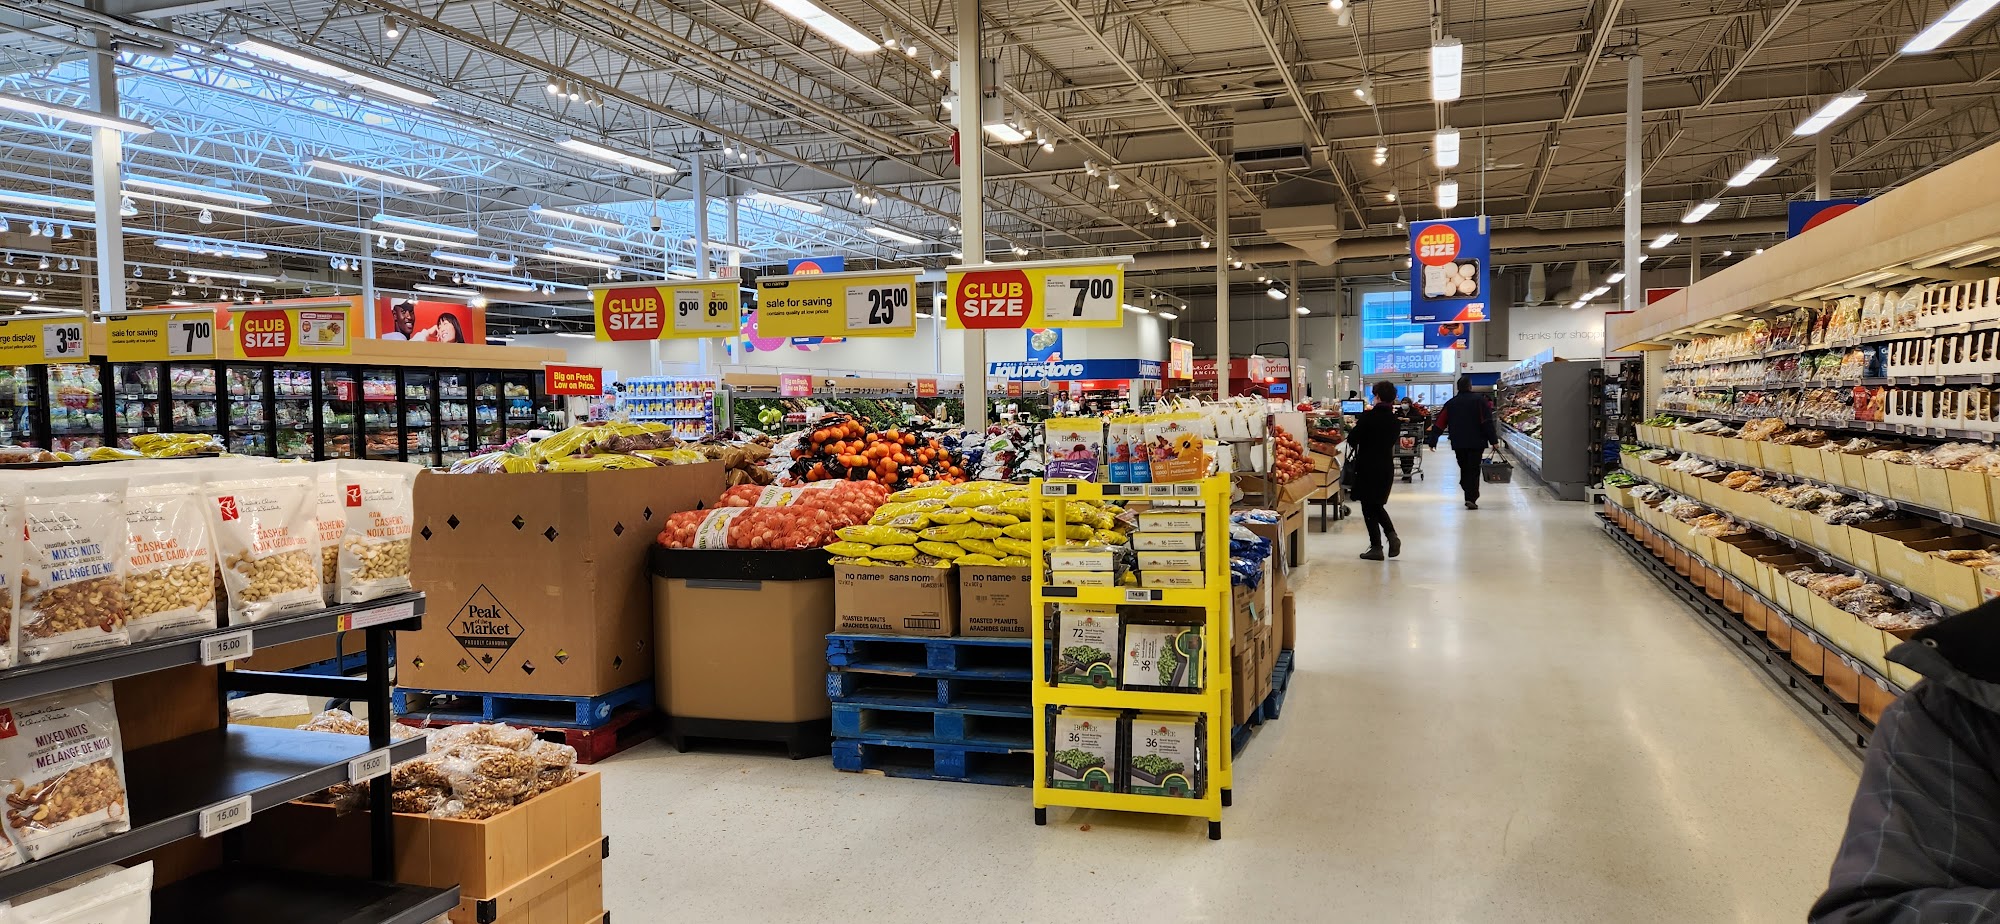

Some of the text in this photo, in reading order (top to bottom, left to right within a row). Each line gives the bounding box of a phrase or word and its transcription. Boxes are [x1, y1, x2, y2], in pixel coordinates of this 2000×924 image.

[1420, 233, 1455, 246] CLUB
[1420, 244, 1455, 257] SIZE
[719, 267, 733, 278] EXIT
[963, 282, 1023, 298] CLUB
[608, 298, 657, 313] CLUB
[766, 296, 832, 308] sale for saving
[963, 298, 1023, 317] SIZE
[244, 319, 285, 332] CLUB
[609, 312, 658, 330] SIZE
[0, 333, 36, 345] rge display
[112, 329, 125, 337] sale
[136, 328, 158, 337] saving
[1518, 329, 1605, 341] thanks for shoppi
[245, 332, 285, 348] SIZE
[553, 372, 595, 383] Big on Fresh,
[553, 381, 568, 389] Low
[577, 381, 595, 390] Price.
[374, 516, 404, 527] CASHEWS
[326, 531, 334, 540] DE
[366, 528, 385, 537] NOIX
[386, 526, 395, 536] DE
[44, 541, 67, 549] Unsalted
[52, 543, 101, 560] MIXED NUTS
[137, 538, 178, 554] CASHEWS
[131, 554, 152, 566] NOIX
[153, 552, 165, 563] DE
[166, 548, 188, 561] CAJOU
[51, 561, 114, 583] MÉLANGE DE NOI
[1021, 574, 1031, 582] sa
[468, 604, 501, 618] Peak
[461, 621, 510, 635] Market
[1072, 629, 1083, 637] 72
[217, 639, 240, 652] 15.00
[1141, 660, 1151, 672] 36
[35, 730, 65, 747] MIXED
[65, 723, 88, 739] NUTS
[1069, 732, 1080, 742] 36
[1146, 738, 1157, 747] 36
[36, 745, 80, 769] MÉLANGE
[82, 742, 93, 754] DE
[94, 737, 112, 751] NOIX
[362, 758, 381, 771] 15.00
[216, 807, 239, 822] 15.00
